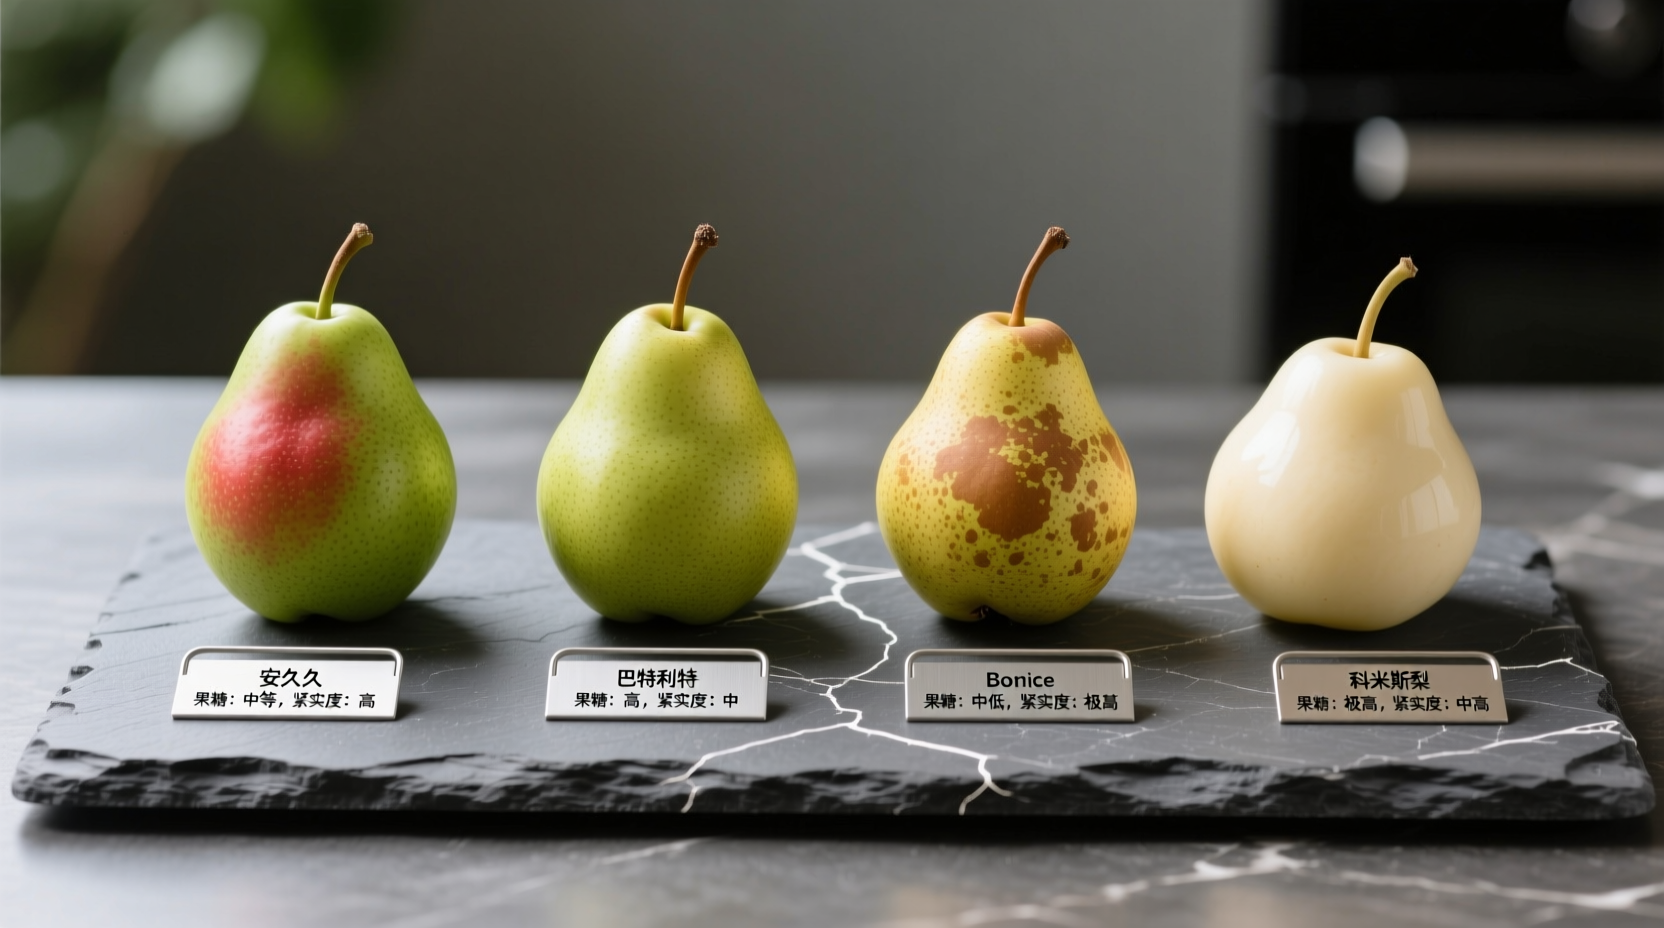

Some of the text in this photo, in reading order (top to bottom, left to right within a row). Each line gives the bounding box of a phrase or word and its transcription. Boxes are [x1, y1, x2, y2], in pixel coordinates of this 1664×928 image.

[259, 668, 322, 687] 安久久
[617, 668, 699, 688] 巴特利特
[986, 672, 1055, 688] Bonice
[1348, 670, 1430, 690] 科米斯梨
